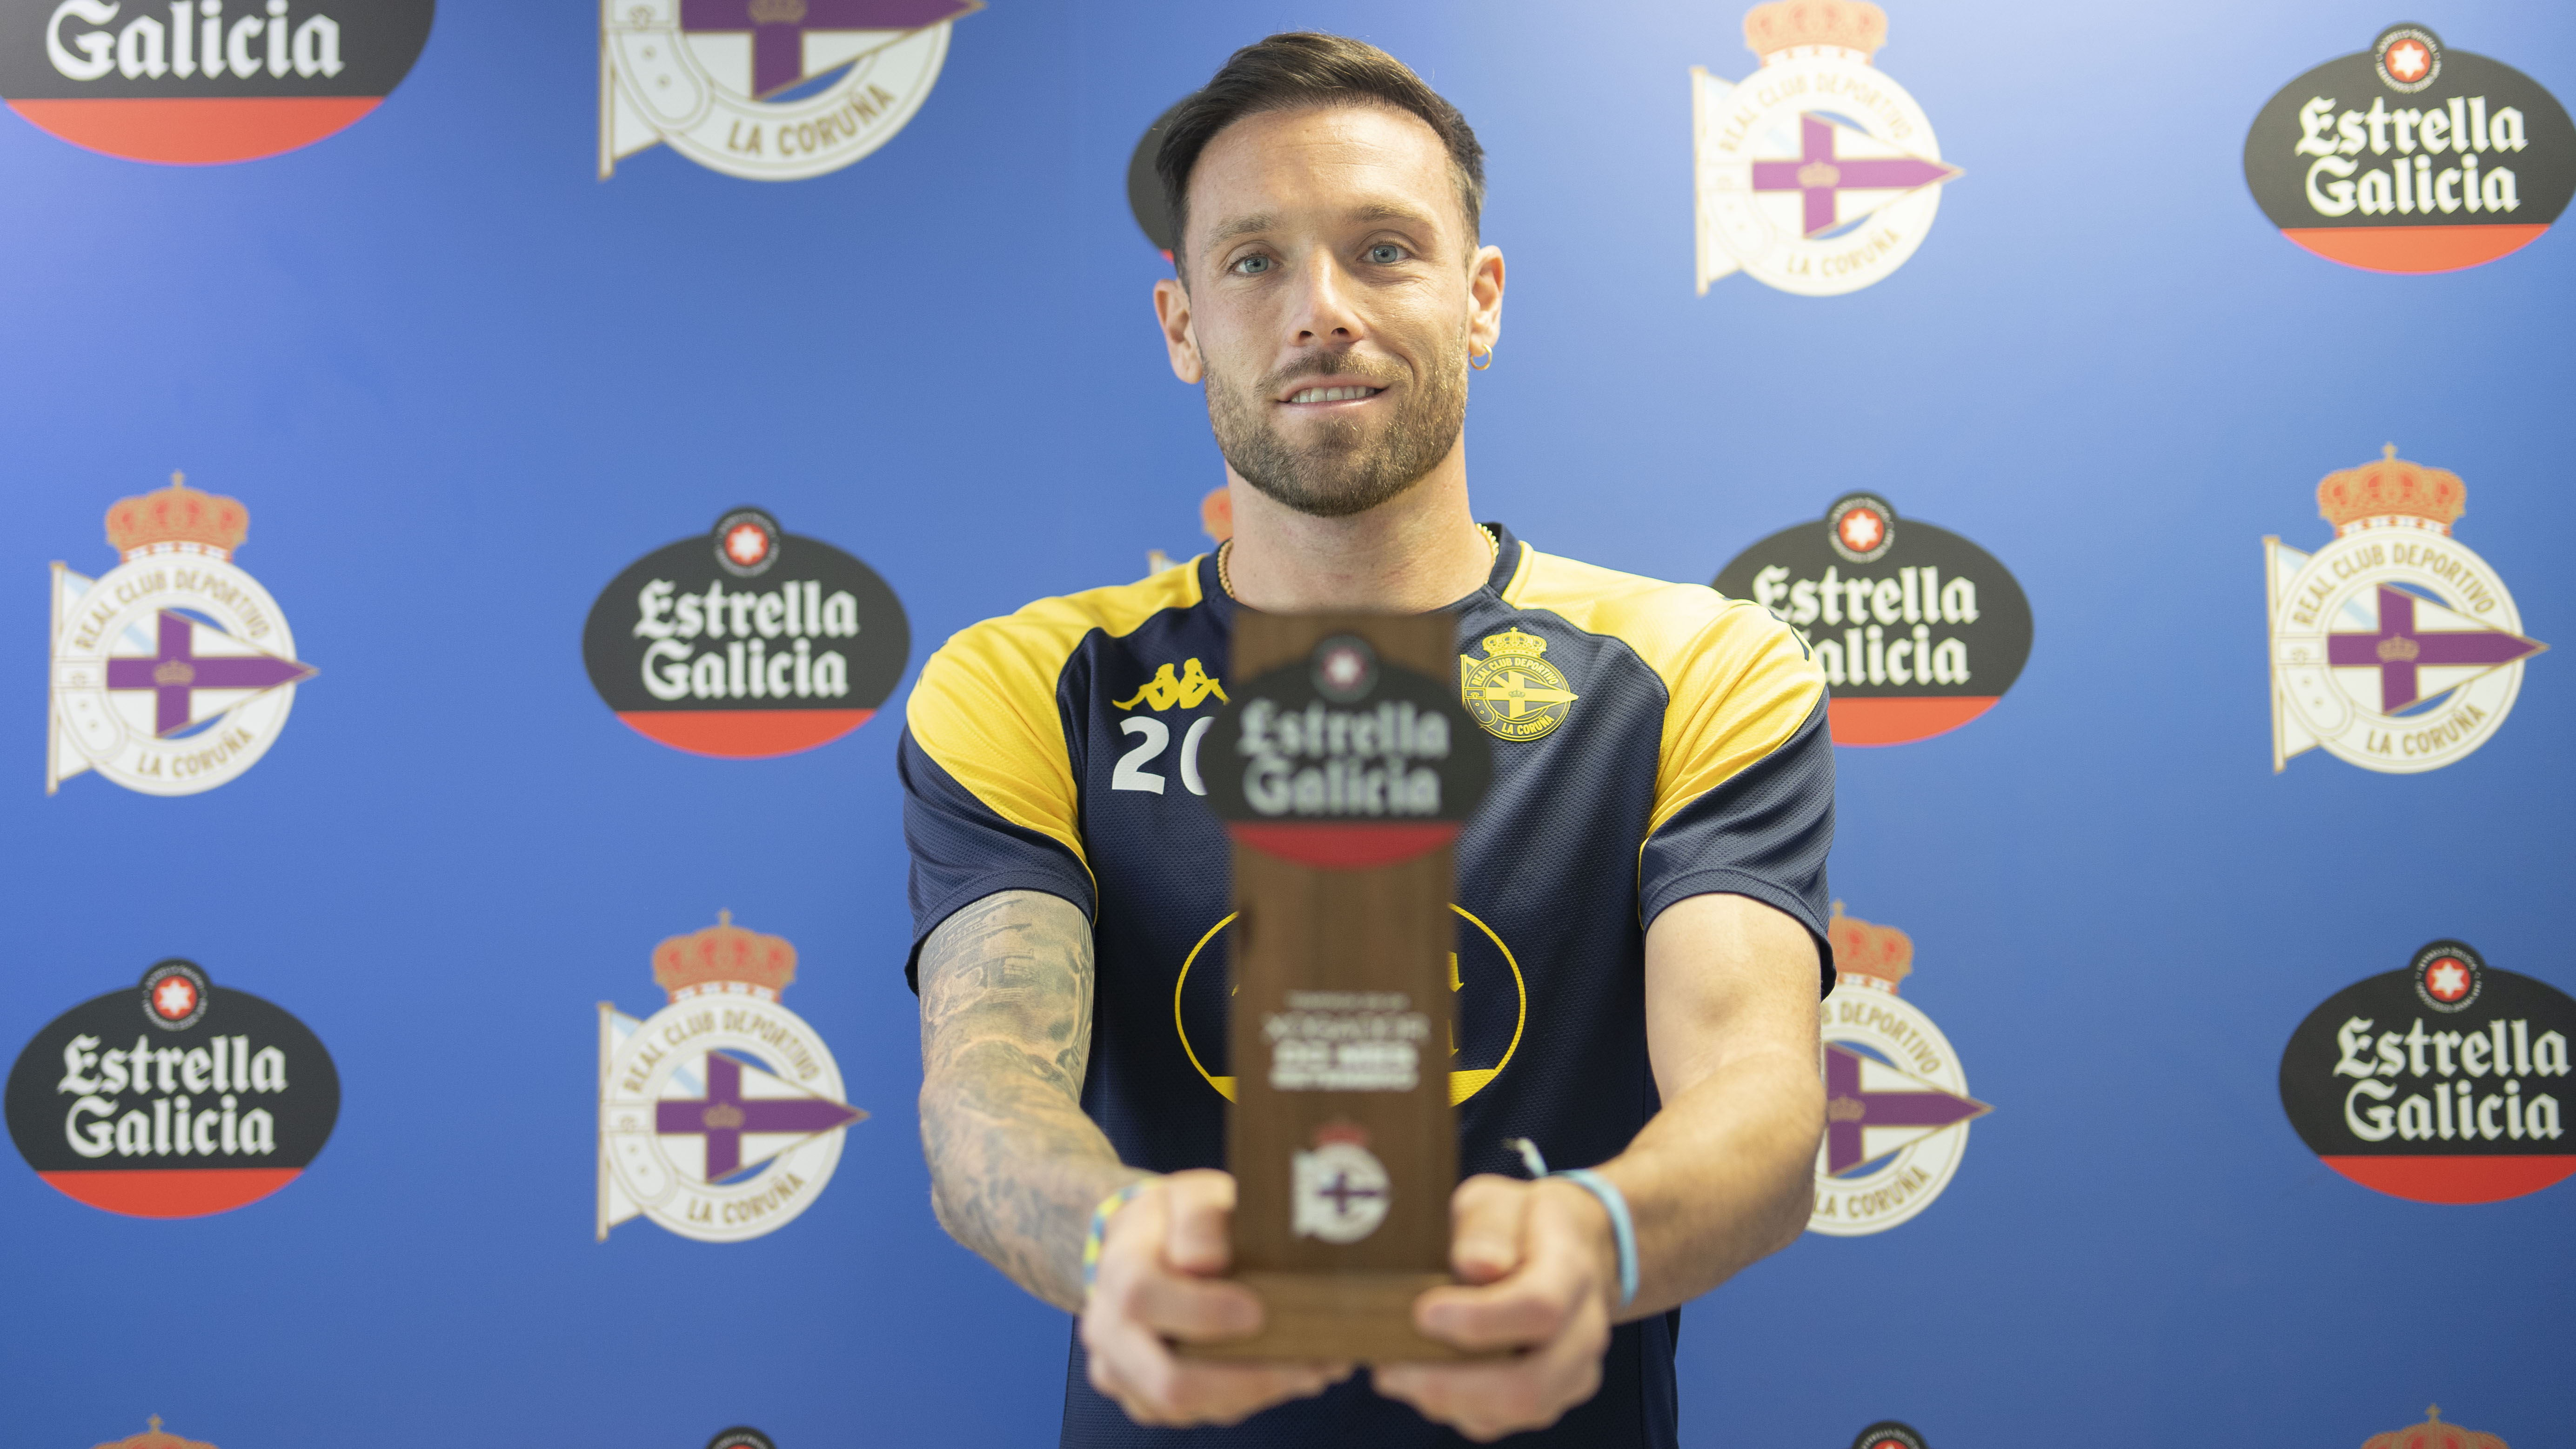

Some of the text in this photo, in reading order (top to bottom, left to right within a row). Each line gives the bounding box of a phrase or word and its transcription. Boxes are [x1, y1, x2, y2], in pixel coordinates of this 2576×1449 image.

[46, 0, 345, 80] Galicia
[728, 83, 896, 156] LA CORUÑA
[1758, 74, 1808, 107] CLUB
[2295, 95, 2528, 156] Estrella
[2305, 154, 2521, 217] Galicia
[1787, 254, 1811, 275] LA
[75, 568, 270, 649] REAL CLUB DEPORTIVO
[633, 578, 860, 640] Estrella
[1753, 565, 1979, 626] Estrella
[2293, 543, 2495, 626] REAL CLUB DEPORTIVO
[641, 637, 850, 701] Galicia
[1471, 657, 1559, 686] REAL CLUB DEPORTIVO
[1801, 623, 1971, 687] alicia
[136, 727, 254, 778] LA CORUÑA
[1235, 698, 1451, 759] Estrella
[1501, 714, 1555, 735] LA CORUÑA
[2367, 704, 2487, 756] LA CORUÑA
[1242, 749, 1441, 817] Galicia
[57, 1033, 288, 1096] Estrella
[624, 1009, 819, 1094] REAL CLUB DEPORTIVO
[1840, 1001, 1941, 1074] DEPORTIVO
[2332, 1015, 2573, 1078] Estrella
[66, 1094, 277, 1158] Galicia
[2344, 1079, 2565, 1142] Galicia
[688, 1172, 806, 1225] LA CORUÑA
[1815, 1165, 1932, 1218] LA CORUÑA
